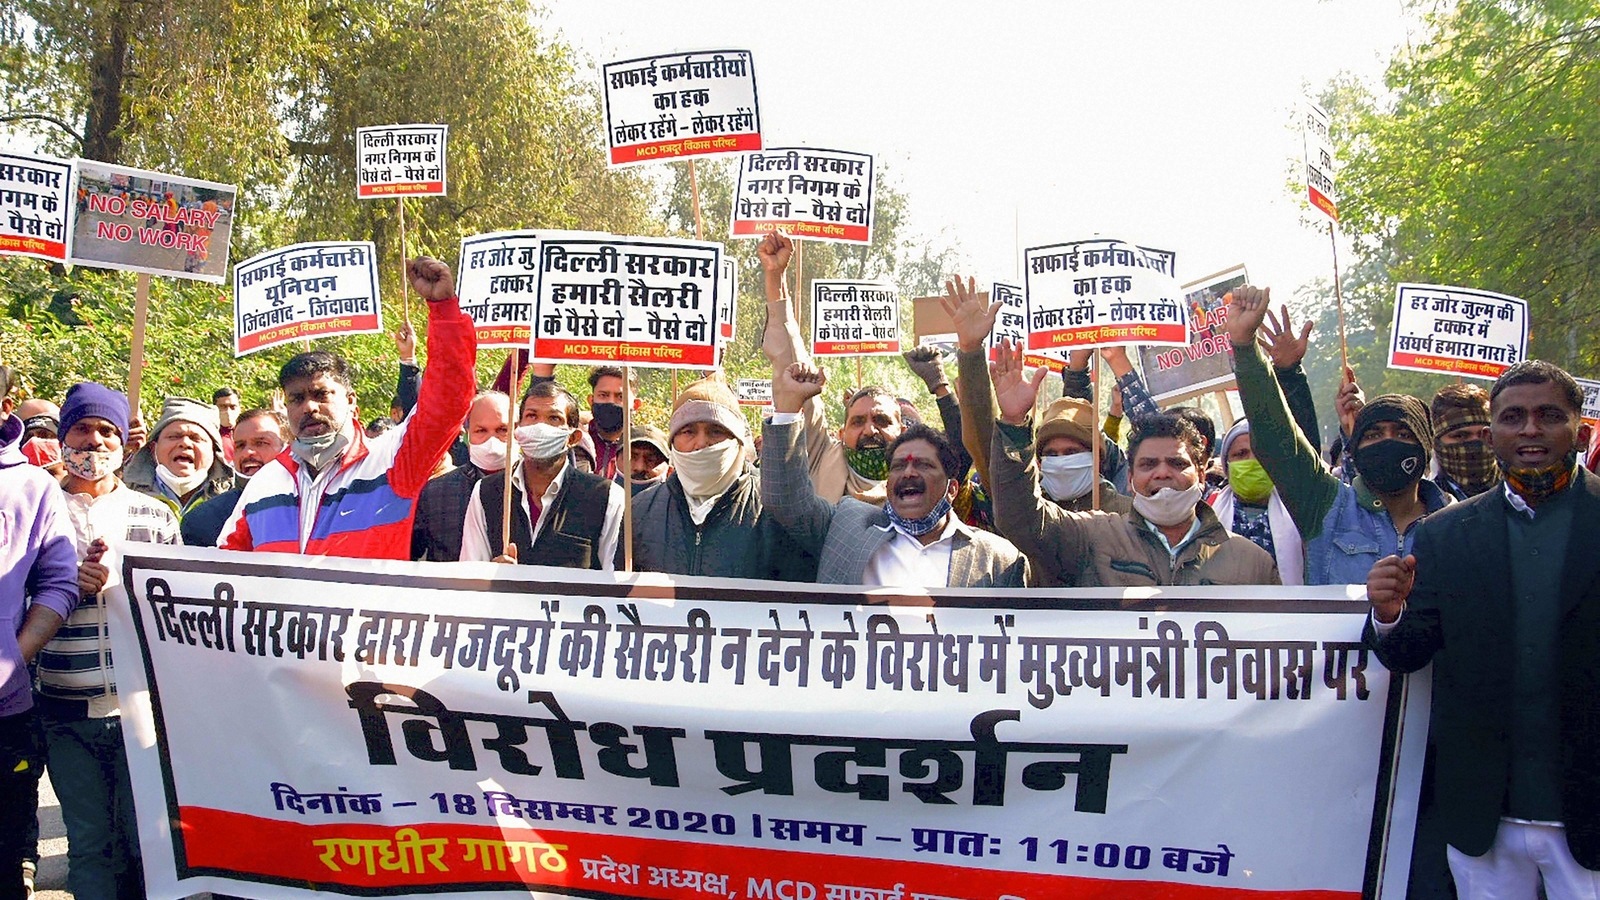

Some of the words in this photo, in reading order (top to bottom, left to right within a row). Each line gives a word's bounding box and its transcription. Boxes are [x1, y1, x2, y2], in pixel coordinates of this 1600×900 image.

[610, 60, 657, 89] सफाई
[661, 54, 747, 81] कर्मचारीयों
[653, 92, 677, 110] का
[680, 88, 709, 108] हक
[615, 120, 647, 143] लेकर
[649, 114, 677, 138] रहेंगे
[692, 111, 725, 134] लेकर
[727, 108, 754, 131] रहेंगे
[364, 132, 395, 148] दिल्ली
[397, 133, 438, 145] सरकार
[365, 153, 386, 165] नगर
[389, 149, 421, 163] निगम
[424, 147, 436, 162] के
[749, 151, 801, 172] दिल्ली
[804, 156, 865, 175] सरकार
[0, 163, 62, 188] सरकार
[362, 168, 378, 182] पैसे
[381, 167, 391, 181] दो
[404, 166, 424, 180] पैसे
[428, 165, 440, 179] दो
[748, 179, 784, 194] नगर
[788, 175, 840, 197] निगम
[843, 179, 861, 199] के
[41, 191, 58, 213] के
[89, 194, 125, 215] NO
[131, 200, 221, 228] SALARY
[741, 198, 768, 217] पैसे
[772, 198, 791, 217] दो
[812, 199, 842, 221] पैसे
[846, 203, 866, 224] दो
[7, 210, 42, 236] पैसे
[45, 218, 63, 240] दो
[97, 222, 133, 242] NO
[138, 227, 209, 252] WORK
[241, 255, 286, 287] सफाई
[290, 248, 365, 271] कर्मचारी
[471, 250, 486, 269] हर
[488, 242, 515, 266] जोर
[545, 246, 620, 273] दिल्ली
[625, 254, 713, 277] सरकार
[1031, 245, 1079, 274] सफाई
[265, 276, 338, 306] यूनियन
[491, 275, 534, 294] टक्कर
[552, 279, 624, 305] हमारी
[628, 279, 702, 309] सैलरी
[818, 286, 857, 302] दिल्ली
[860, 290, 894, 302] सरकार
[1074, 277, 1097, 296] का
[1101, 276, 1132, 294] हक
[243, 305, 294, 333] जिंदाबाद
[309, 295, 369, 317] जिंदाबाद
[823, 305, 860, 321] हमारी
[863, 304, 891, 321] सैलरी
[1033, 305, 1066, 329] लेकर
[1067, 300, 1095, 324] रहेंगे
[1110, 298, 1146, 321] लेकर
[1149, 298, 1178, 321] रहेंगे
[1411, 296, 1429, 310] हर
[1432, 294, 1459, 313] जोर
[1462, 301, 1495, 319] जुल्म
[1497, 304, 1515, 321] की
[543, 308, 562, 335] के
[565, 308, 599, 336] पैसे
[602, 310, 624, 337] दो
[647, 312, 681, 340] पैसे
[685, 314, 707, 342] दो
[819, 324, 830, 340] के
[832, 324, 850, 339] पैसे
[852, 323, 862, 339] दो
[1434, 319, 1476, 336] टक्कर
[1478, 320, 1491, 338] में
[564, 344, 588, 355] MCD
[591, 346, 616, 359] मजदूर
[620, 344, 650, 356] विकास
[653, 346, 683, 359] परिषद
[1157, 349, 1184, 371] NO
[1399, 332, 1434, 352] संघर्ष
[1435, 340, 1475, 357] हमारा
[1478, 345, 1506, 362] नारा
[1507, 344, 1517, 363] है
[146, 578, 238, 652] दिल्ली
[242, 602, 353, 662] सरकार
[354, 610, 429, 666] द्वारा
[431, 601, 555, 692] मजदूरों
[559, 605, 611, 678] की
[615, 604, 716, 682] सैलरी
[721, 628, 752, 684] न
[758, 610, 814, 687] देने
[821, 611, 859, 688] के
[866, 614, 973, 692] विरोध
[978, 614, 1014, 694] में
[1018, 617, 1188, 709] मुख्यमंत्री
[1194, 621, 1317, 699] निवास
[1322, 642, 1370, 700] पर
[345, 682, 686, 787] विरोध
[704, 710, 1128, 814] प्रदर्शन
[270, 782, 382, 815] दिनांक
[430, 793, 477, 816] 18
[483, 791, 618, 825] दिसम्बर
[627, 808, 735, 835] 2020
[1019, 837, 1151, 869] 11:00
[1161, 845, 1235, 877] बजे
[313, 829, 449, 874] रणधीर
[458, 838, 568, 873] गागठ
[580, 855, 640, 885] प्रदेश
[648, 867, 737, 900] अध्यक्ष,
[747, 877, 817, 900] MCD
